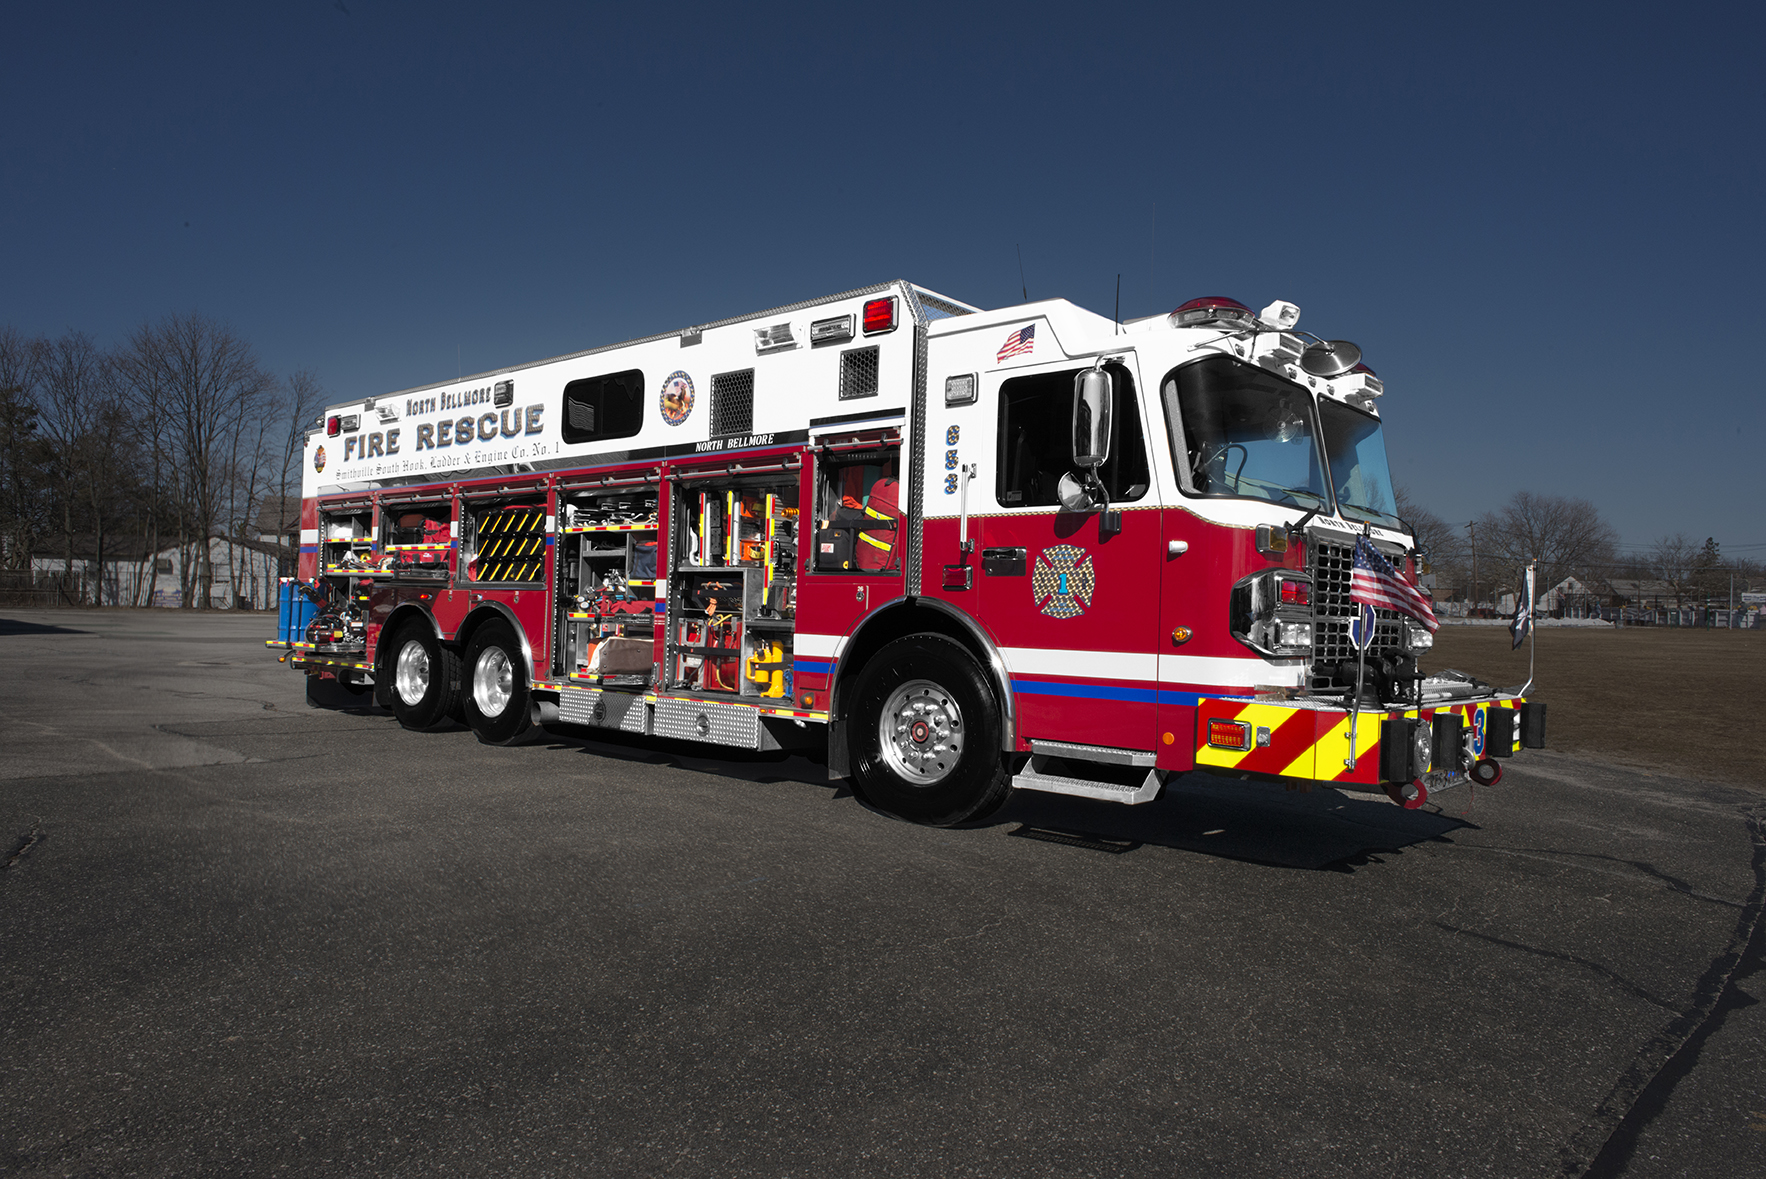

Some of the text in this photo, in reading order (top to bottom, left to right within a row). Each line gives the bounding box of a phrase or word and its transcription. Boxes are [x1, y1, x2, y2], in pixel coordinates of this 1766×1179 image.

[343, 403, 545, 462] FIRE RESCUE
[695, 433, 775, 453] NORTH BELLMORE
[336, 468, 374, 481] Smithville
[376, 462, 401, 476] South
[430, 454, 461, 469] Ladder
[463, 452, 472, 465] &
[474, 450, 508, 464] Engine
[511, 445, 529, 459] Co.
[532, 442, 551, 456] No.
[555, 441, 560, 454] 1
[1058, 573, 1069, 596] 1
[1473, 707, 1486, 756] 3
